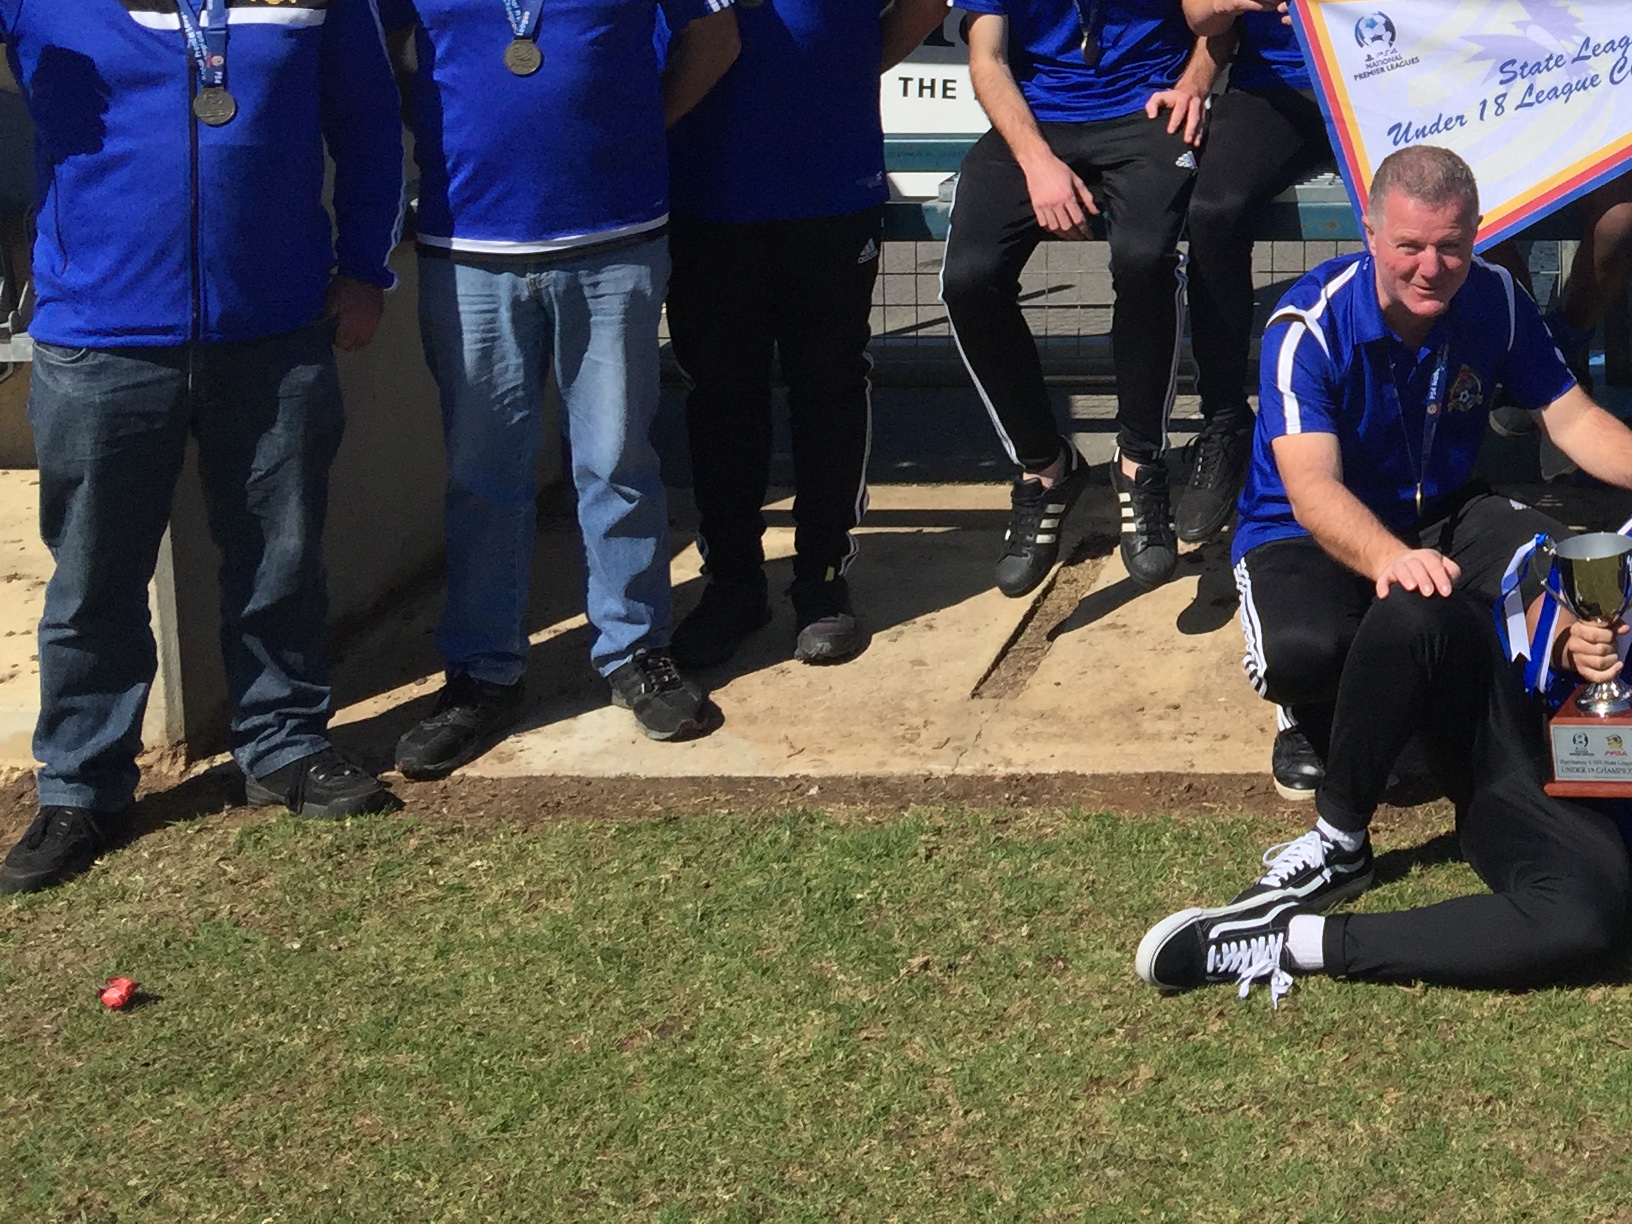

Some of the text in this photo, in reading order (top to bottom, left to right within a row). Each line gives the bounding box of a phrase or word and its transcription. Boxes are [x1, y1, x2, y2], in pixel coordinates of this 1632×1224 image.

[1353, 56, 1420, 81] PREMIER LEAGUES
[1365, 54, 1403, 69] NATIONAL
[1498, 54, 1567, 86] State
[898, 76, 957, 100] THE
[1387, 113, 1469, 147] Under
[1477, 93, 1507, 121] 18
[1513, 71, 1602, 110] League
